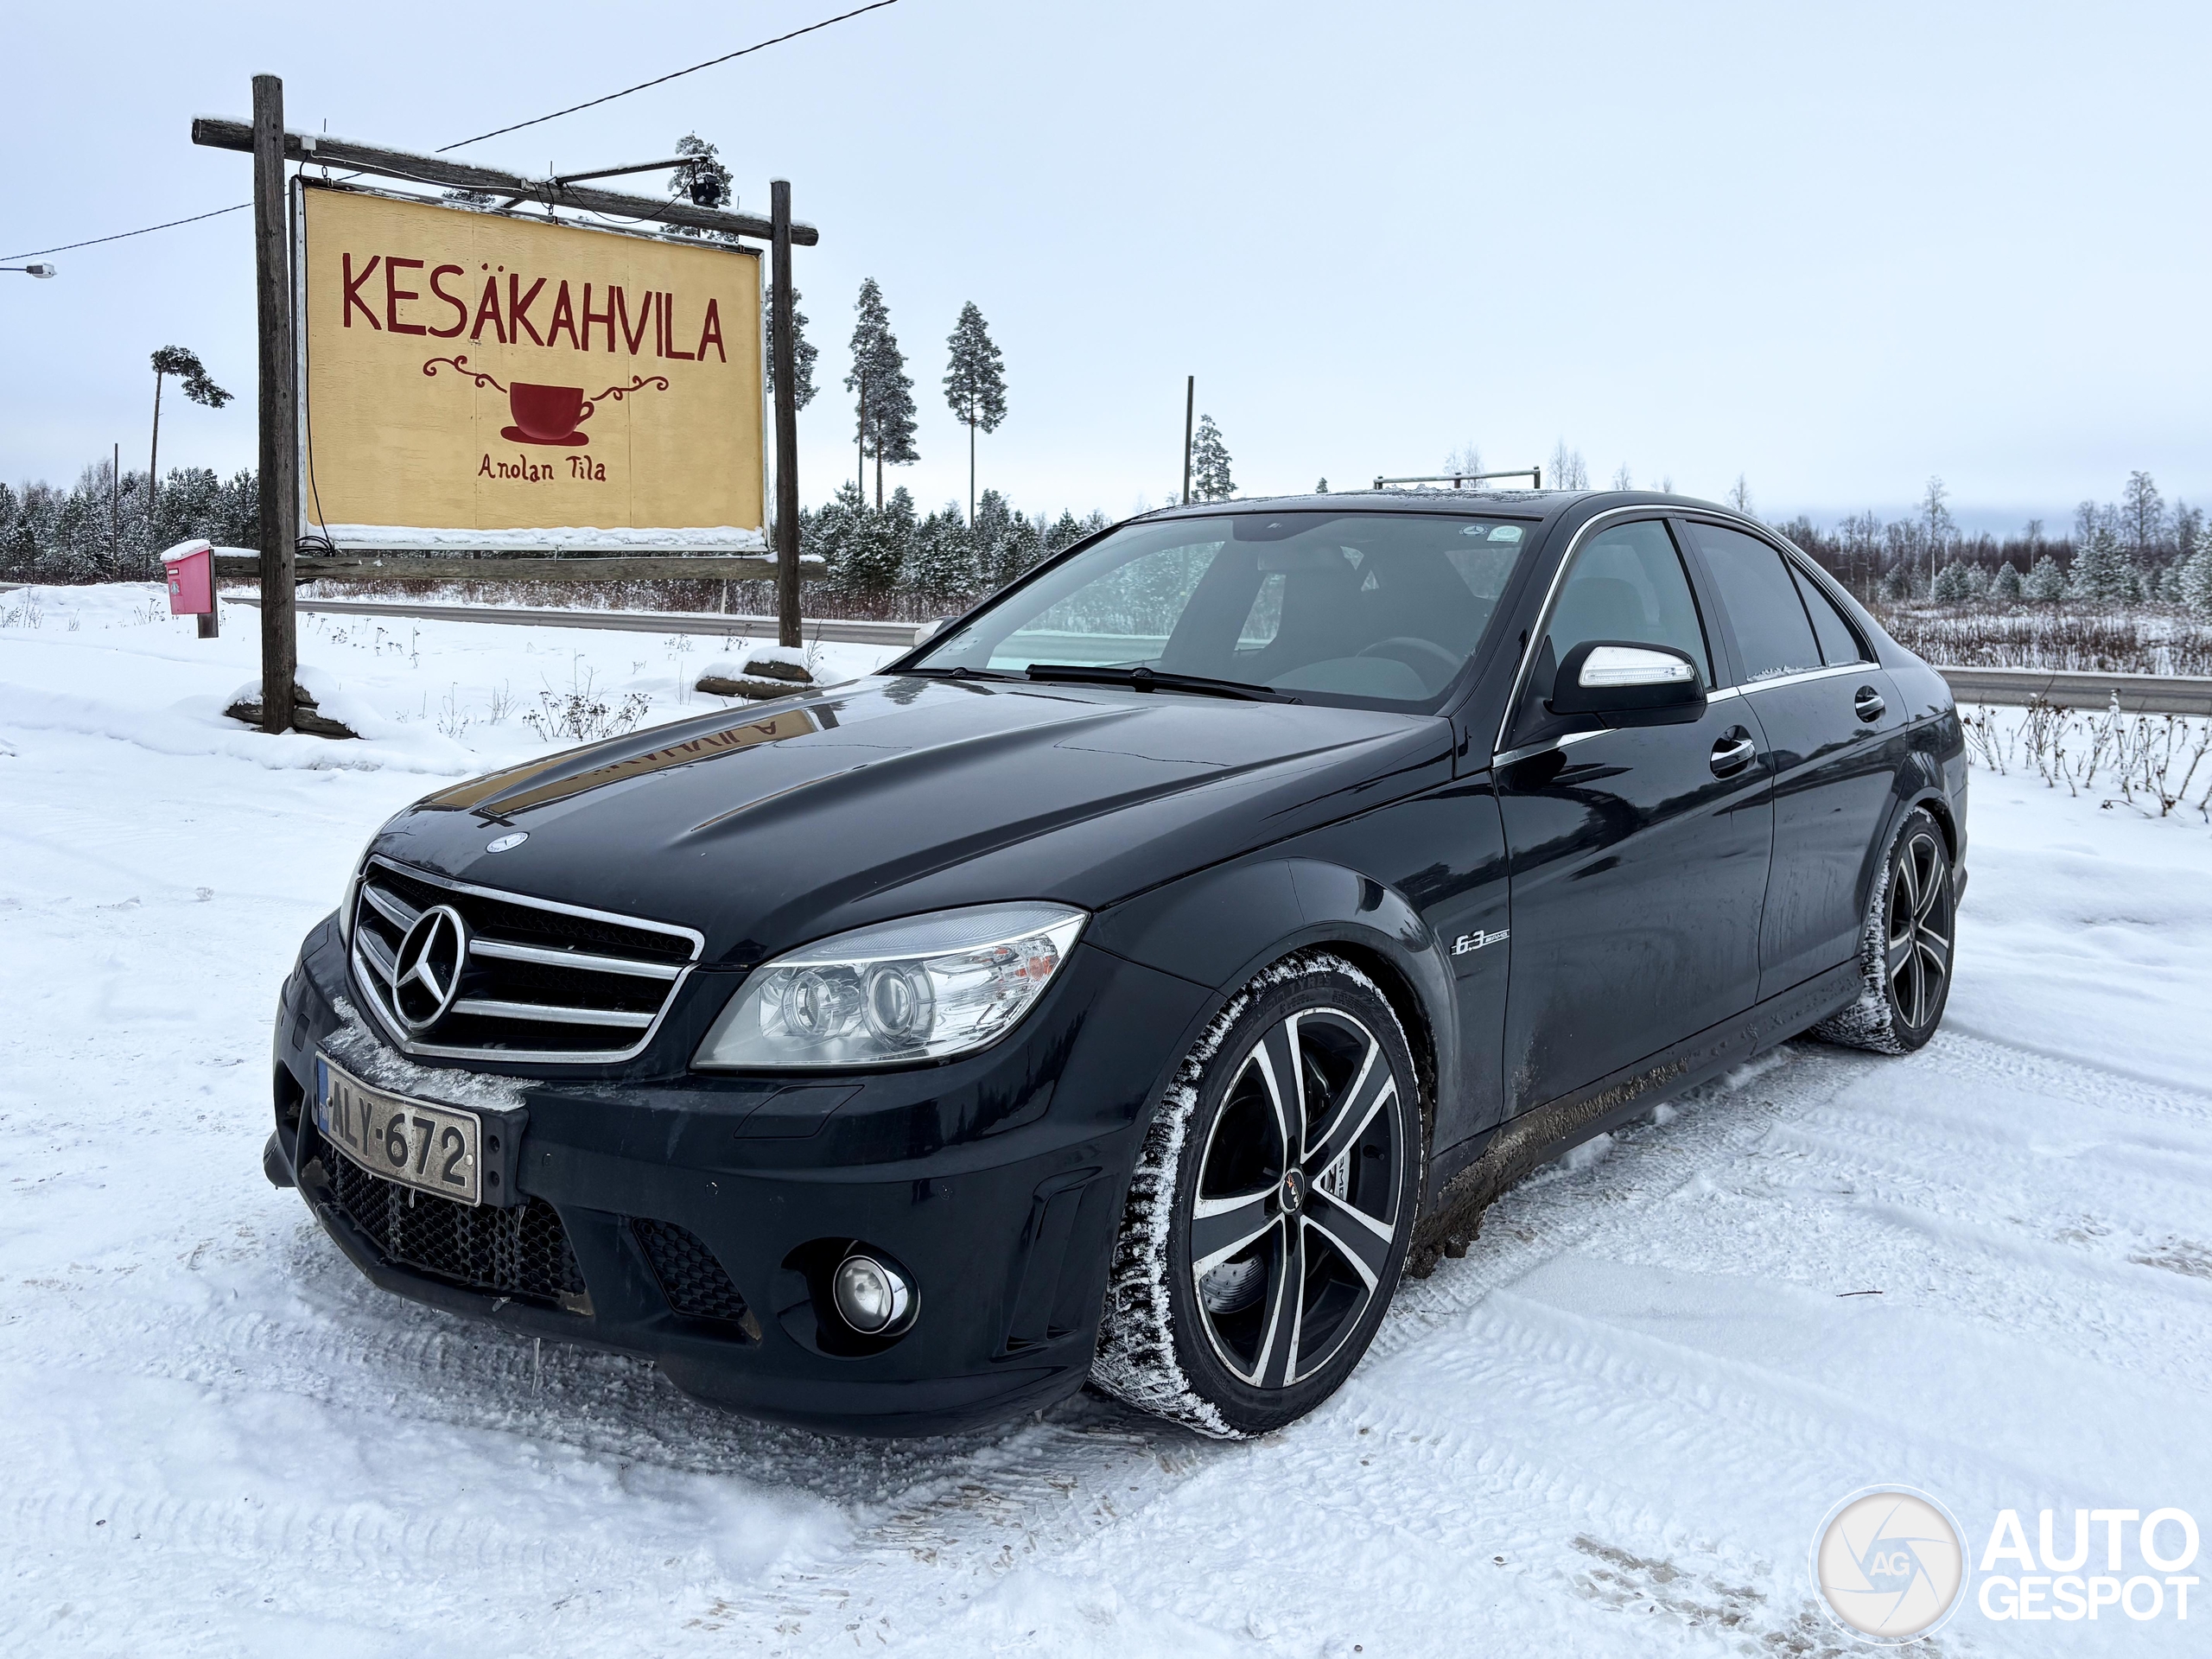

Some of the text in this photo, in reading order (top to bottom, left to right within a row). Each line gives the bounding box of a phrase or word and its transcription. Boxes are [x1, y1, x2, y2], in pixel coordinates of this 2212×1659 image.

[342, 252, 727, 363] KESÄKAHVILA
[478, 454, 606, 482] Anolan Tila
[332, 1080, 467, 1187] ALY-672
